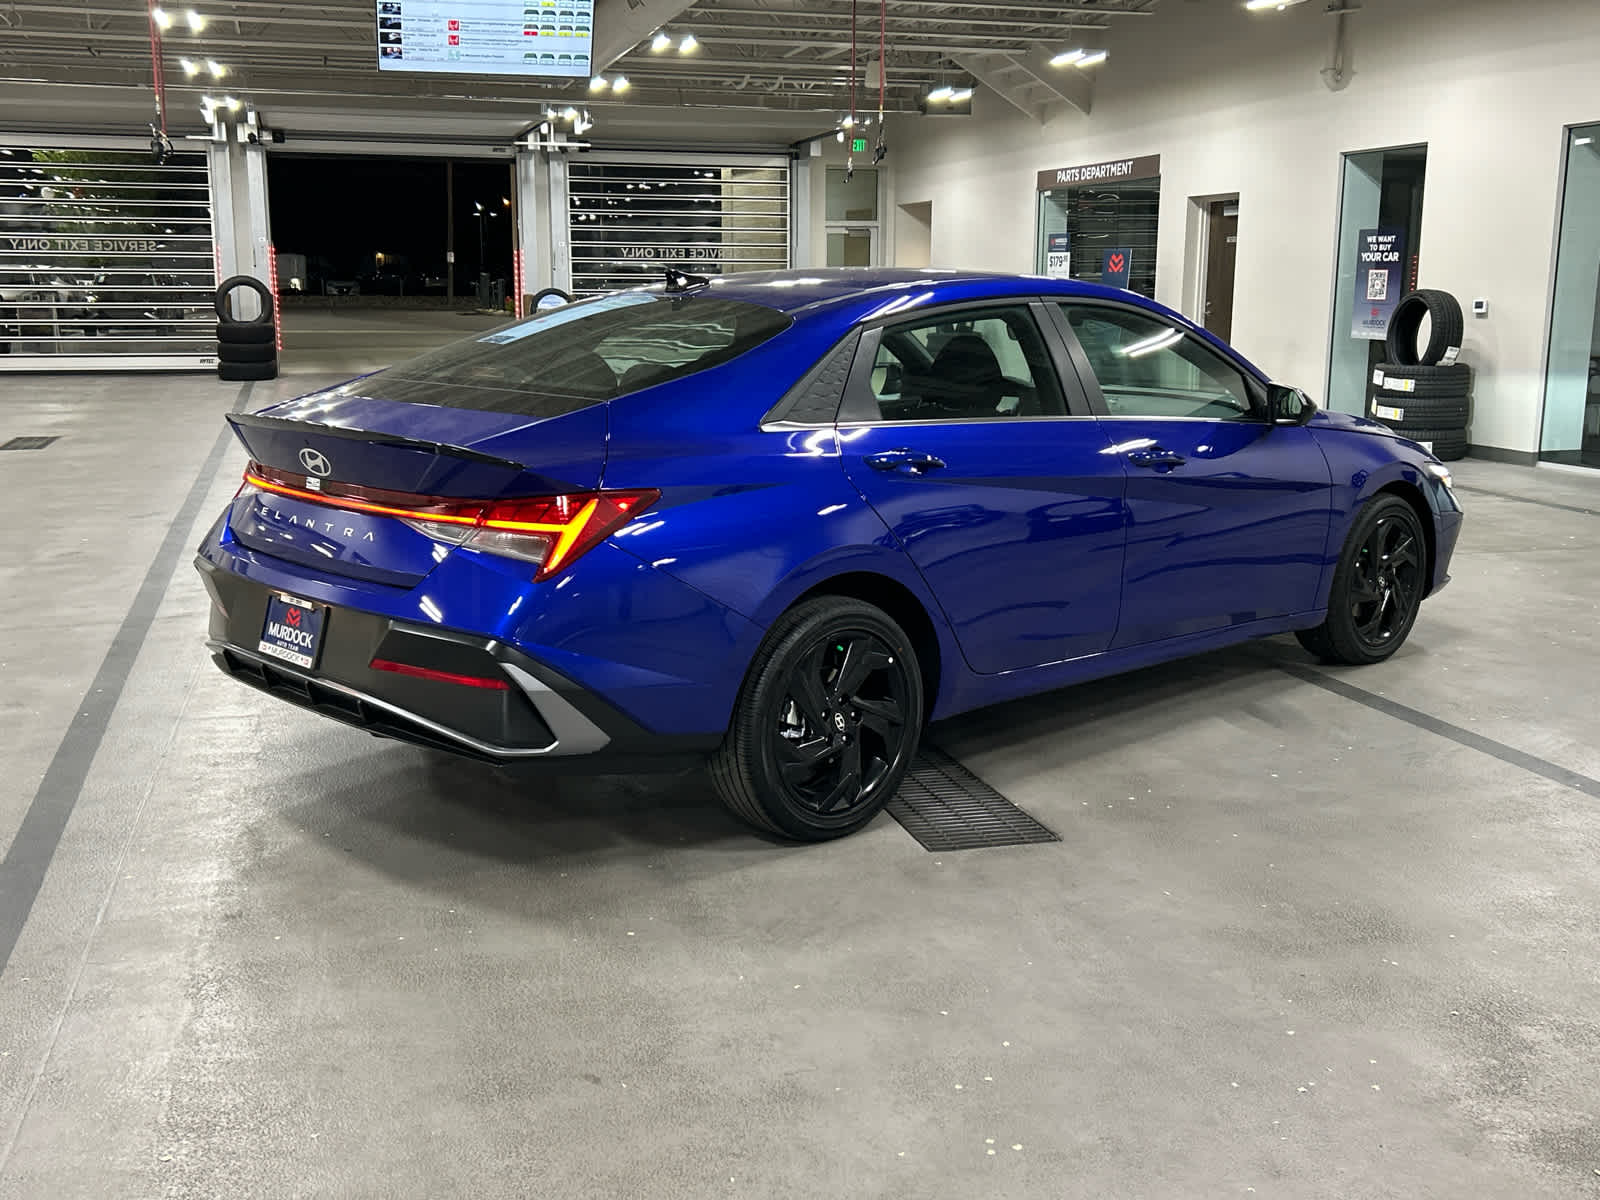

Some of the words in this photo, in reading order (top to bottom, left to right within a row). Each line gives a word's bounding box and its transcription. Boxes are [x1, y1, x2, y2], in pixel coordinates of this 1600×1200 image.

[1056, 168, 1080, 183] PARTS
[1080, 160, 1134, 181] DEPARTMENT
[1366, 235, 1377, 243] WE
[1377, 235, 1396, 243] WANT
[1361, 252, 1382, 262] YOUR
[1382, 252, 1400, 262] CAR
[260, 506, 375, 542] ELANTRA
[267, 621, 315, 649] MURDOCK
